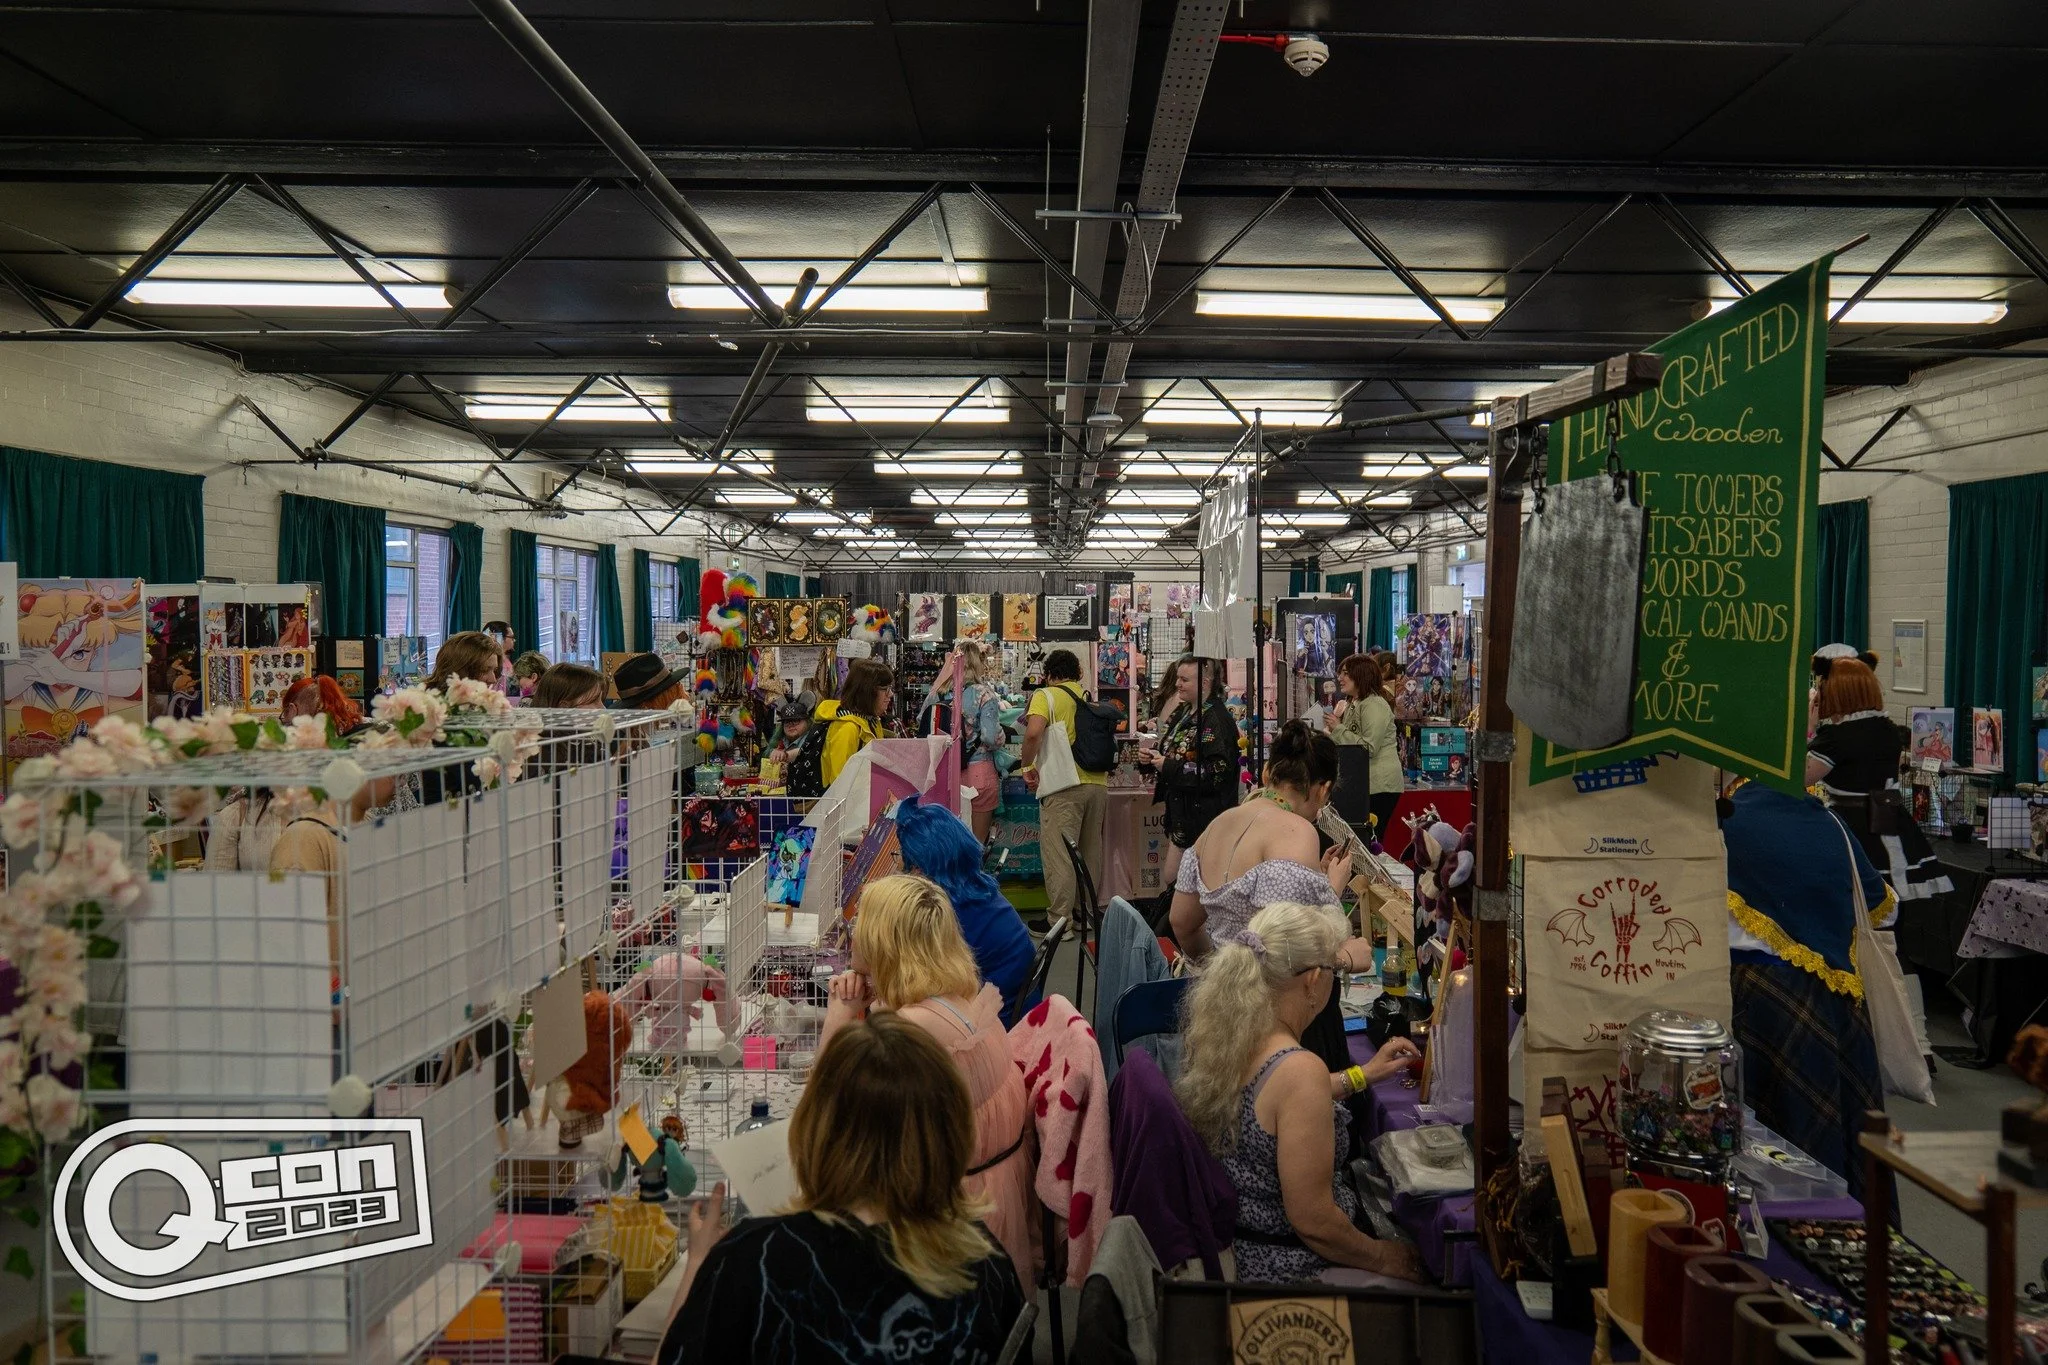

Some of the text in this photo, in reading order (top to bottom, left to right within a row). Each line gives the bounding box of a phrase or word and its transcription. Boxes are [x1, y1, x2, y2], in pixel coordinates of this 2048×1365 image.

[1654, 407, 1783, 443] Wooden
[1675, 473, 1784, 517] TOWERS
[1648, 516, 1782, 558] TSABERS
[1643, 558, 1745, 598] ORDS
[1701, 601, 1788, 642] WANDS
[1599, 846, 1640, 855] Stationery
[1602, 836, 1638, 845] SilkMoth
[1578, 877, 1671, 914] Corroded
[1570, 962, 1586, 971] 1986
[1590, 950, 1653, 985] Coffin
[1666, 972, 1675, 981] IN
[1603, 1022, 1627, 1031] SilkM
[1246, 1312, 1339, 1355] OLLIVANDERS
